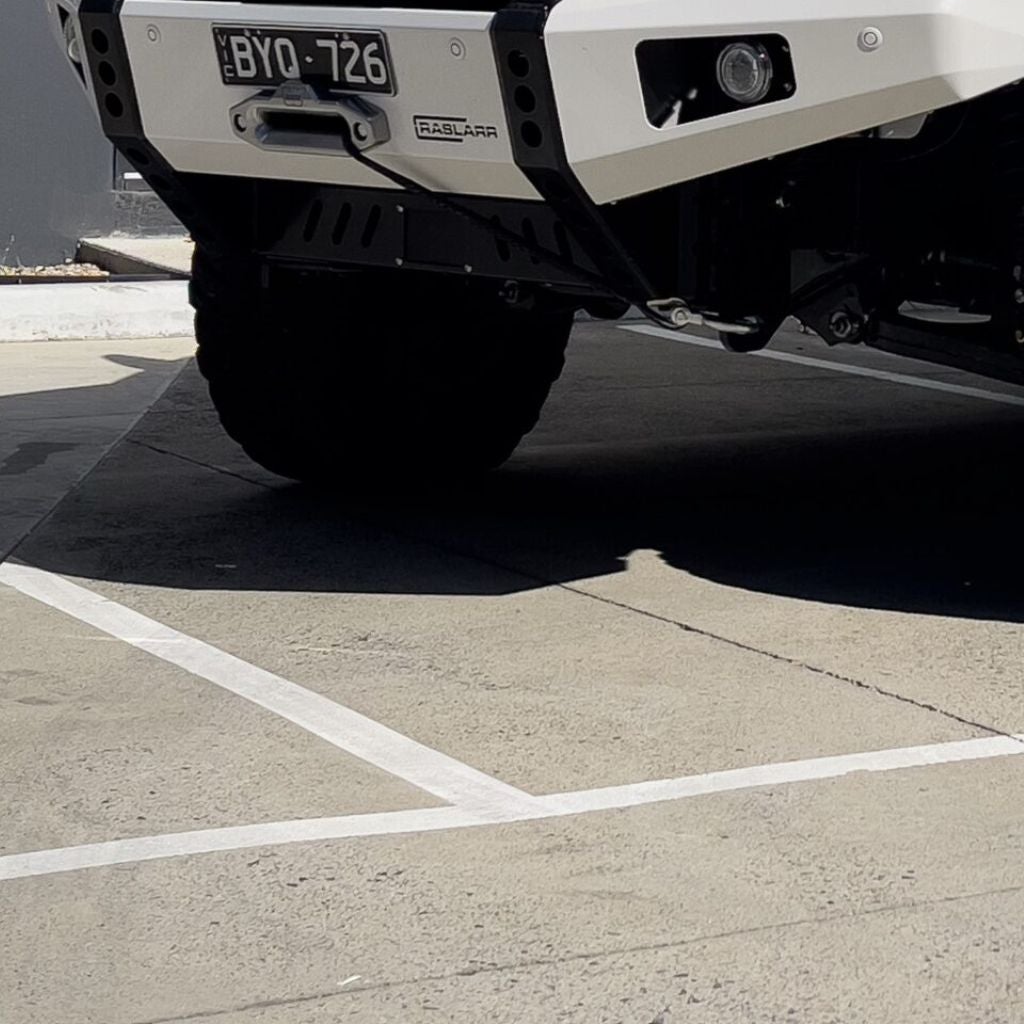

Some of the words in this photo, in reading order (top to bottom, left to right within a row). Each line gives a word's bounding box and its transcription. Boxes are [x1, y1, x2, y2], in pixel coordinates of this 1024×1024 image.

[217, 34, 234, 77] VIC
[315, 38, 387, 85] 726
[419, 121, 498, 138] RASLARR
